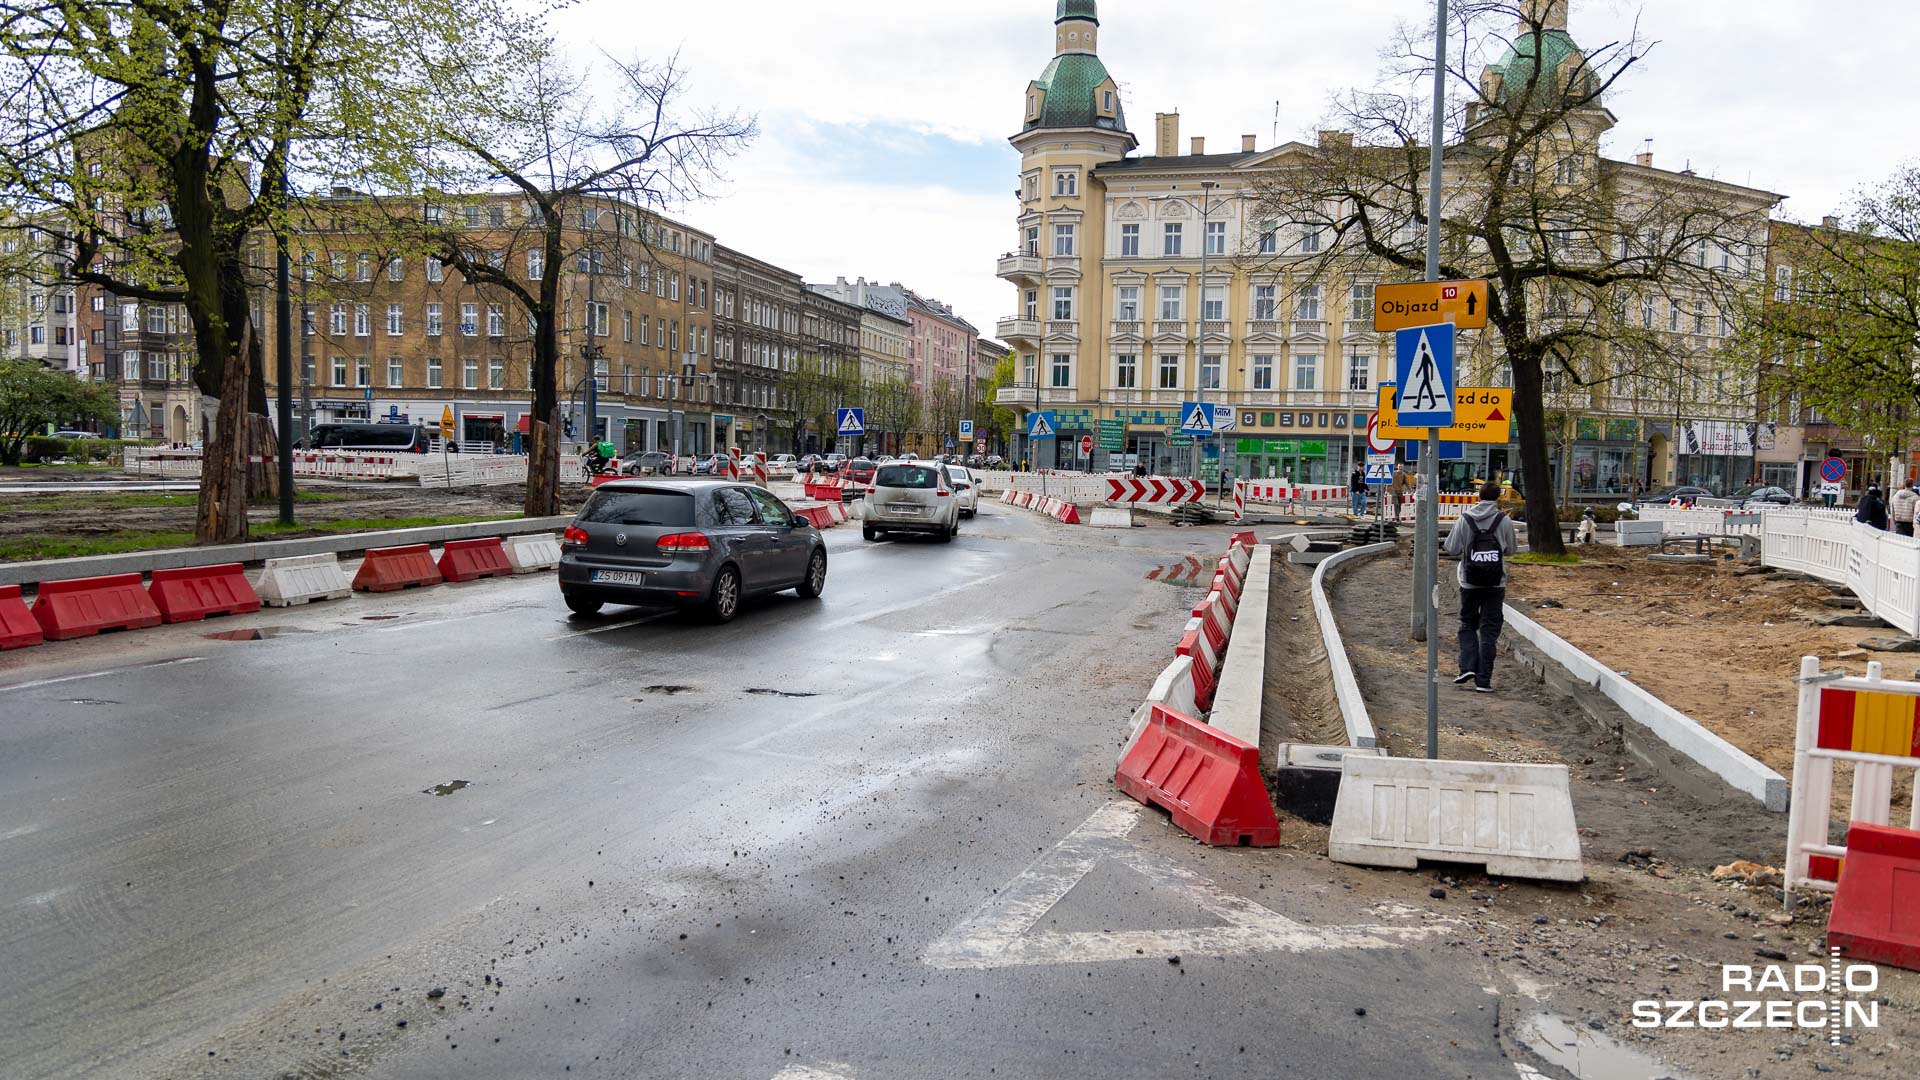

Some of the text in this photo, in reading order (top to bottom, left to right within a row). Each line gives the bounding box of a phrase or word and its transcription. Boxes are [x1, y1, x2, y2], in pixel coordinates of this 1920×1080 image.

[1444, 288, 1456, 298] 10
[1381, 298, 1439, 316] Objazd
[1479, 391, 1500, 404] do
[1214, 407, 1231, 417] MTM
[1715, 432, 1733, 441] Kino
[1702, 441, 1733, 451] Pionier
[1470, 548, 1500, 562] VANS
[598, 570, 641, 583] ZS 091AV
